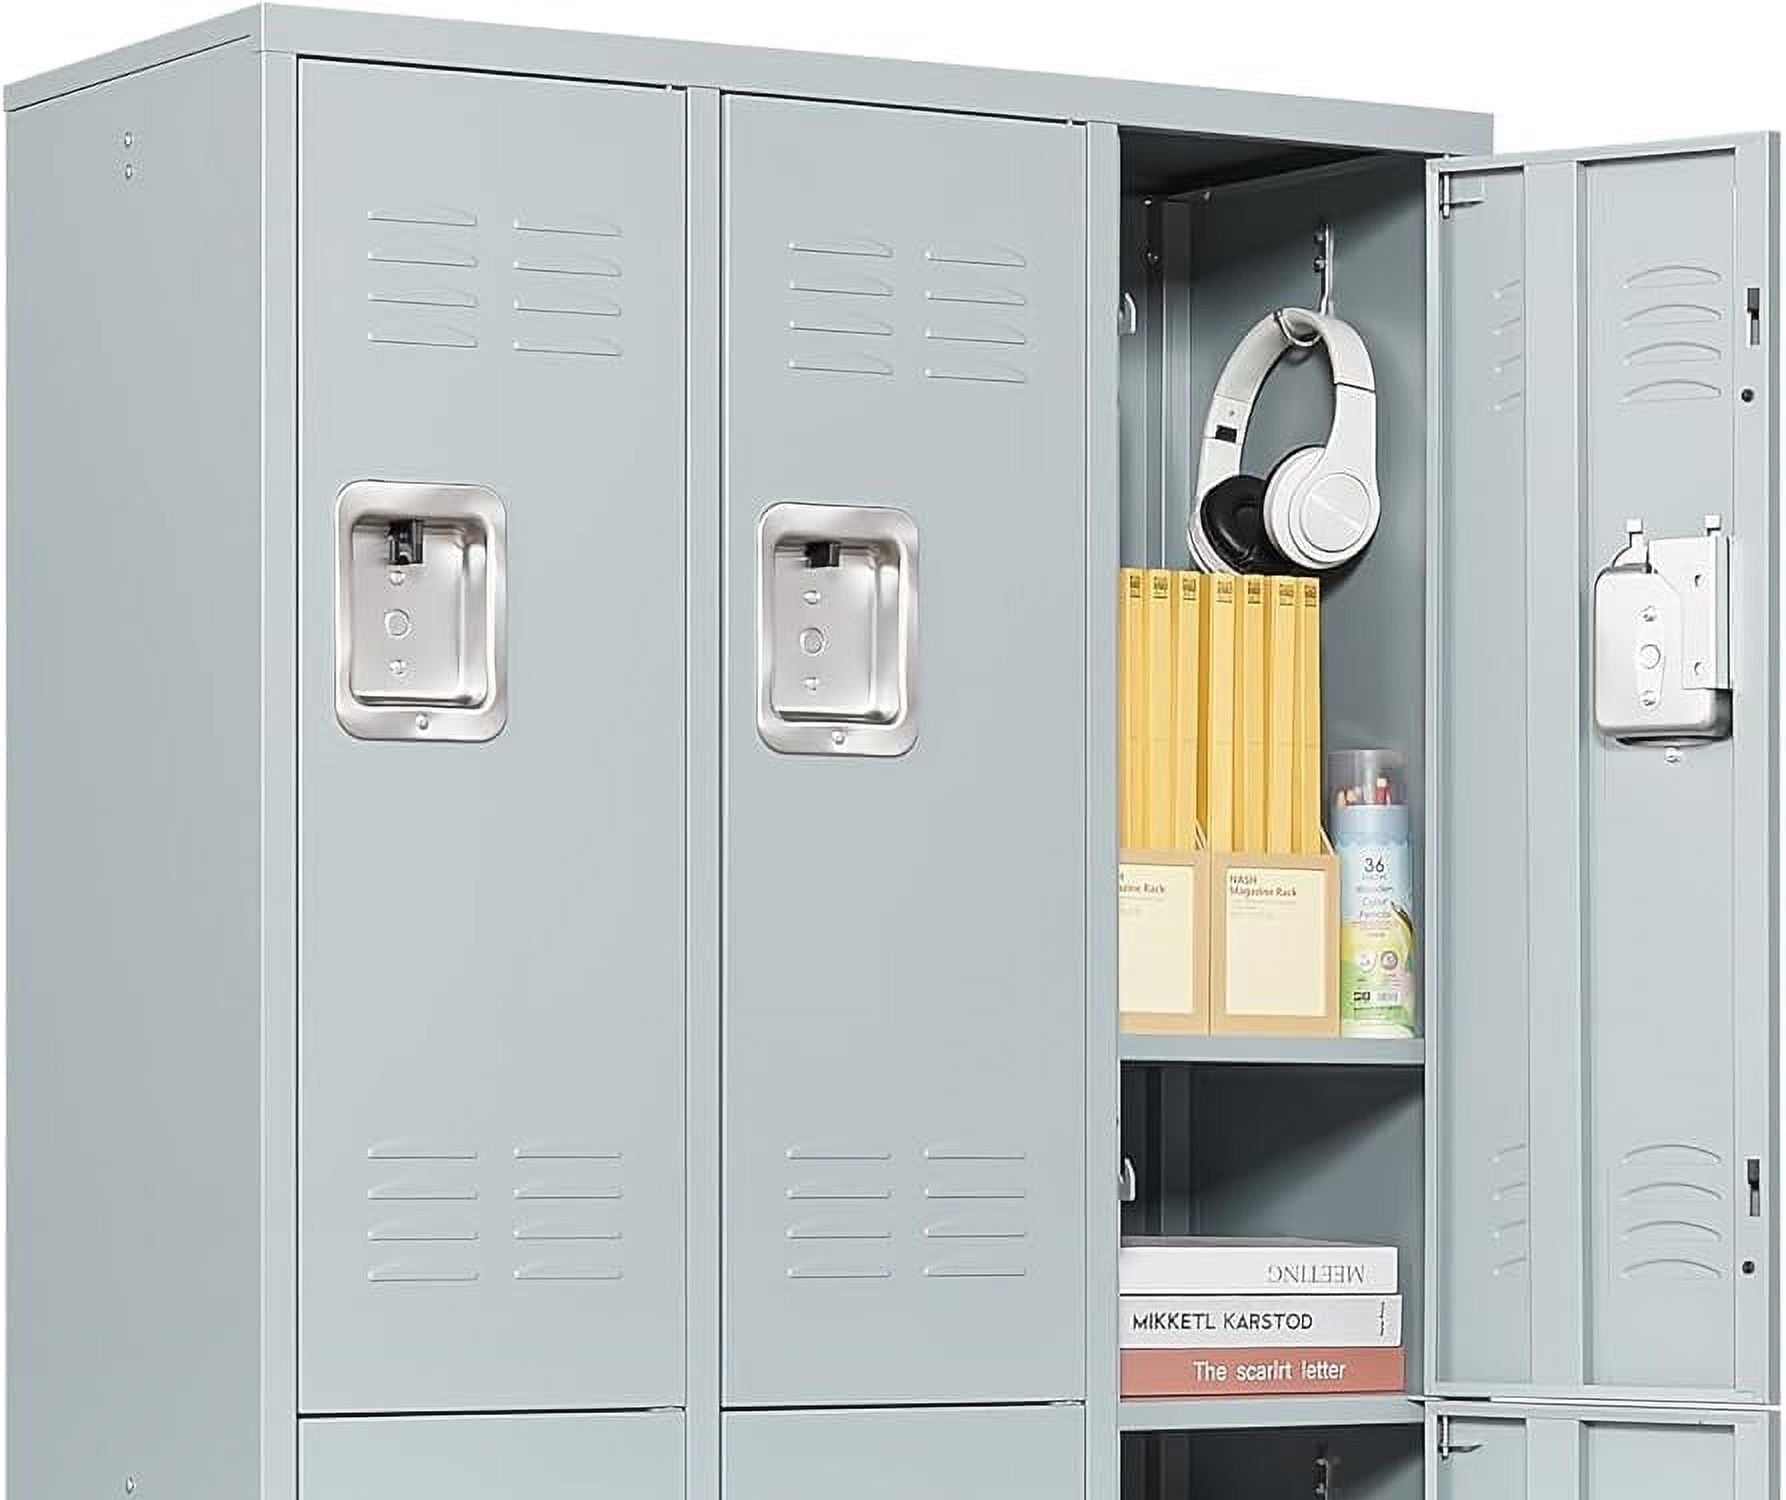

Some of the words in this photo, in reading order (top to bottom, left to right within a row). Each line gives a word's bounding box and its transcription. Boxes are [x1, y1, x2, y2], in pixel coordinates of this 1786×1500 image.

[1364, 855, 1385, 873] 36
[1230, 875, 1257, 885] NASH
[1230, 885, 1274, 898] Magazine
[1276, 887, 1297, 897] Rack
[1268, 1264, 1365, 1284] MEETING
[1132, 1312, 1216, 1330] MIKKETL
[1223, 1312, 1313, 1330] KARSTOD
[1193, 1360, 1227, 1382] The
[1302, 1359, 1346, 1380] letter
